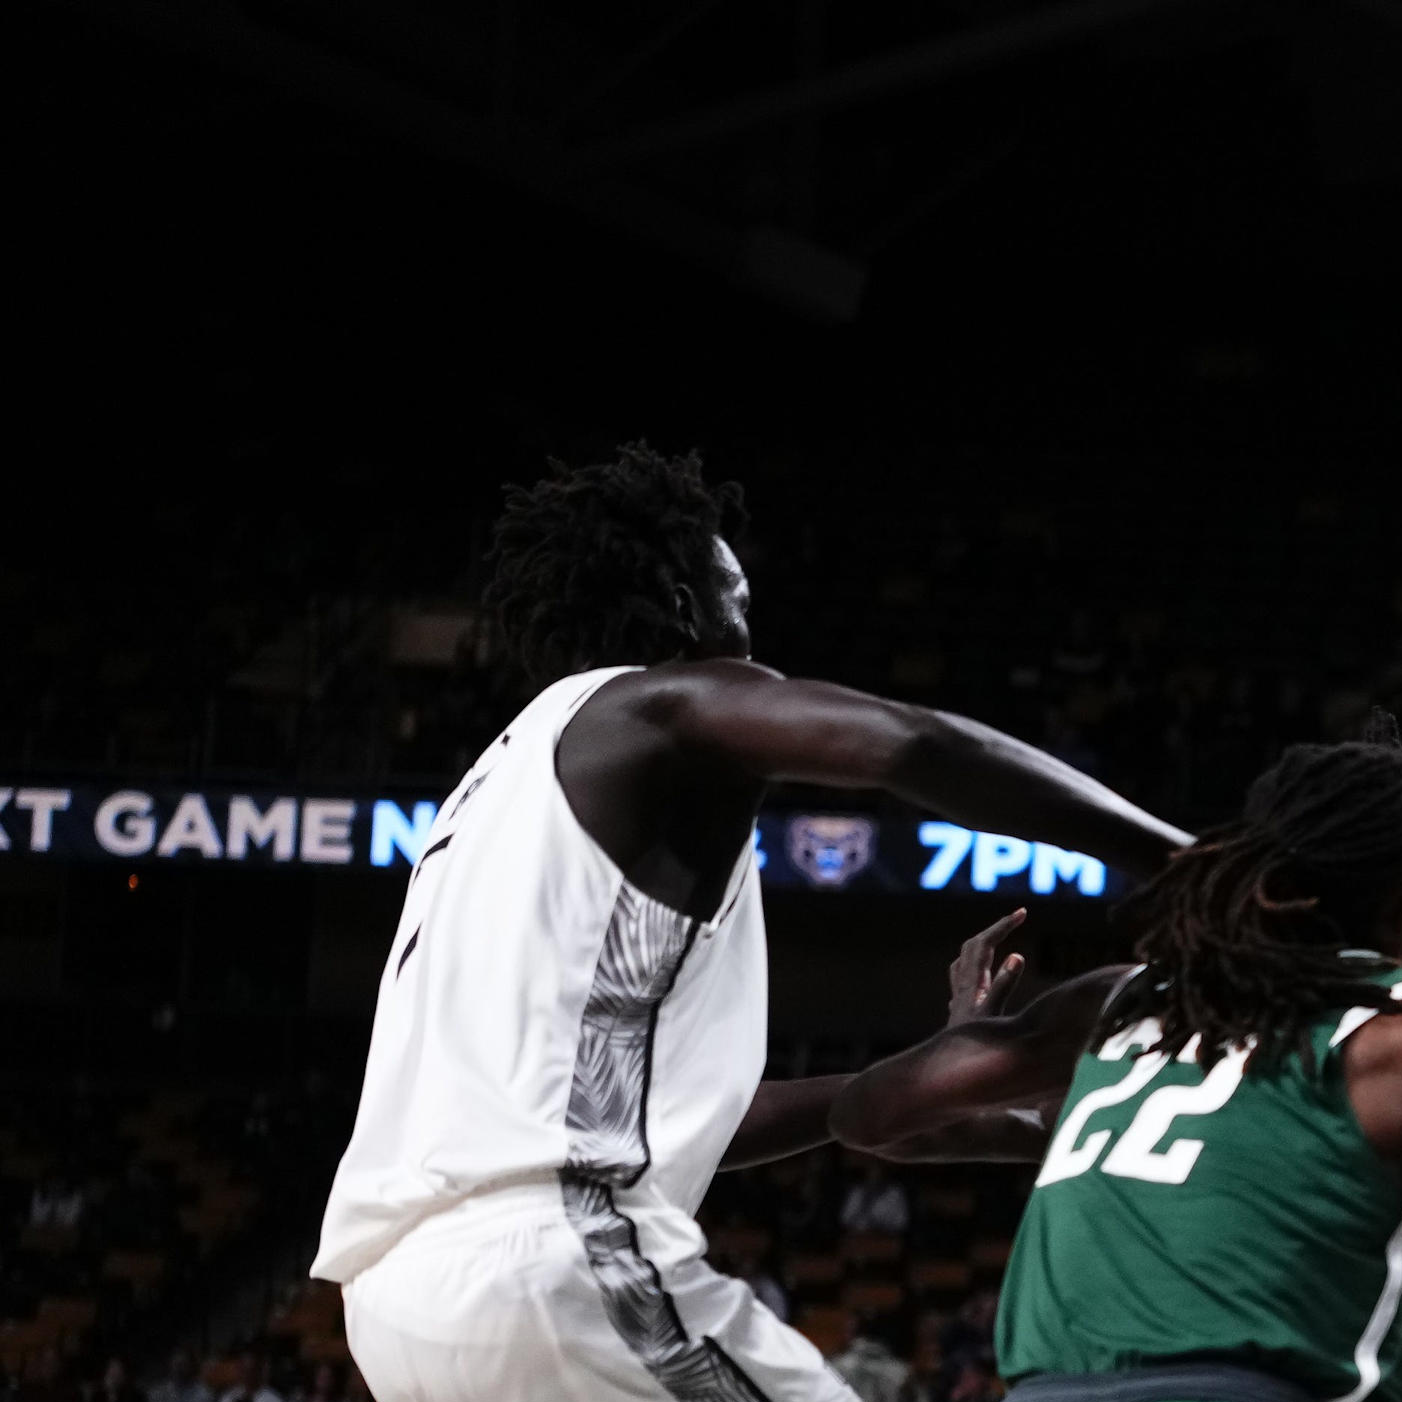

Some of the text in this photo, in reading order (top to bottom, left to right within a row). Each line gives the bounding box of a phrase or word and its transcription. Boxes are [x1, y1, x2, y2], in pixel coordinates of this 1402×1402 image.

[0, 787, 72, 852] T
[94, 790, 357, 864] GAME
[918, 821, 1106, 896] 7PM
[1037, 1017, 1258, 1187] 22
